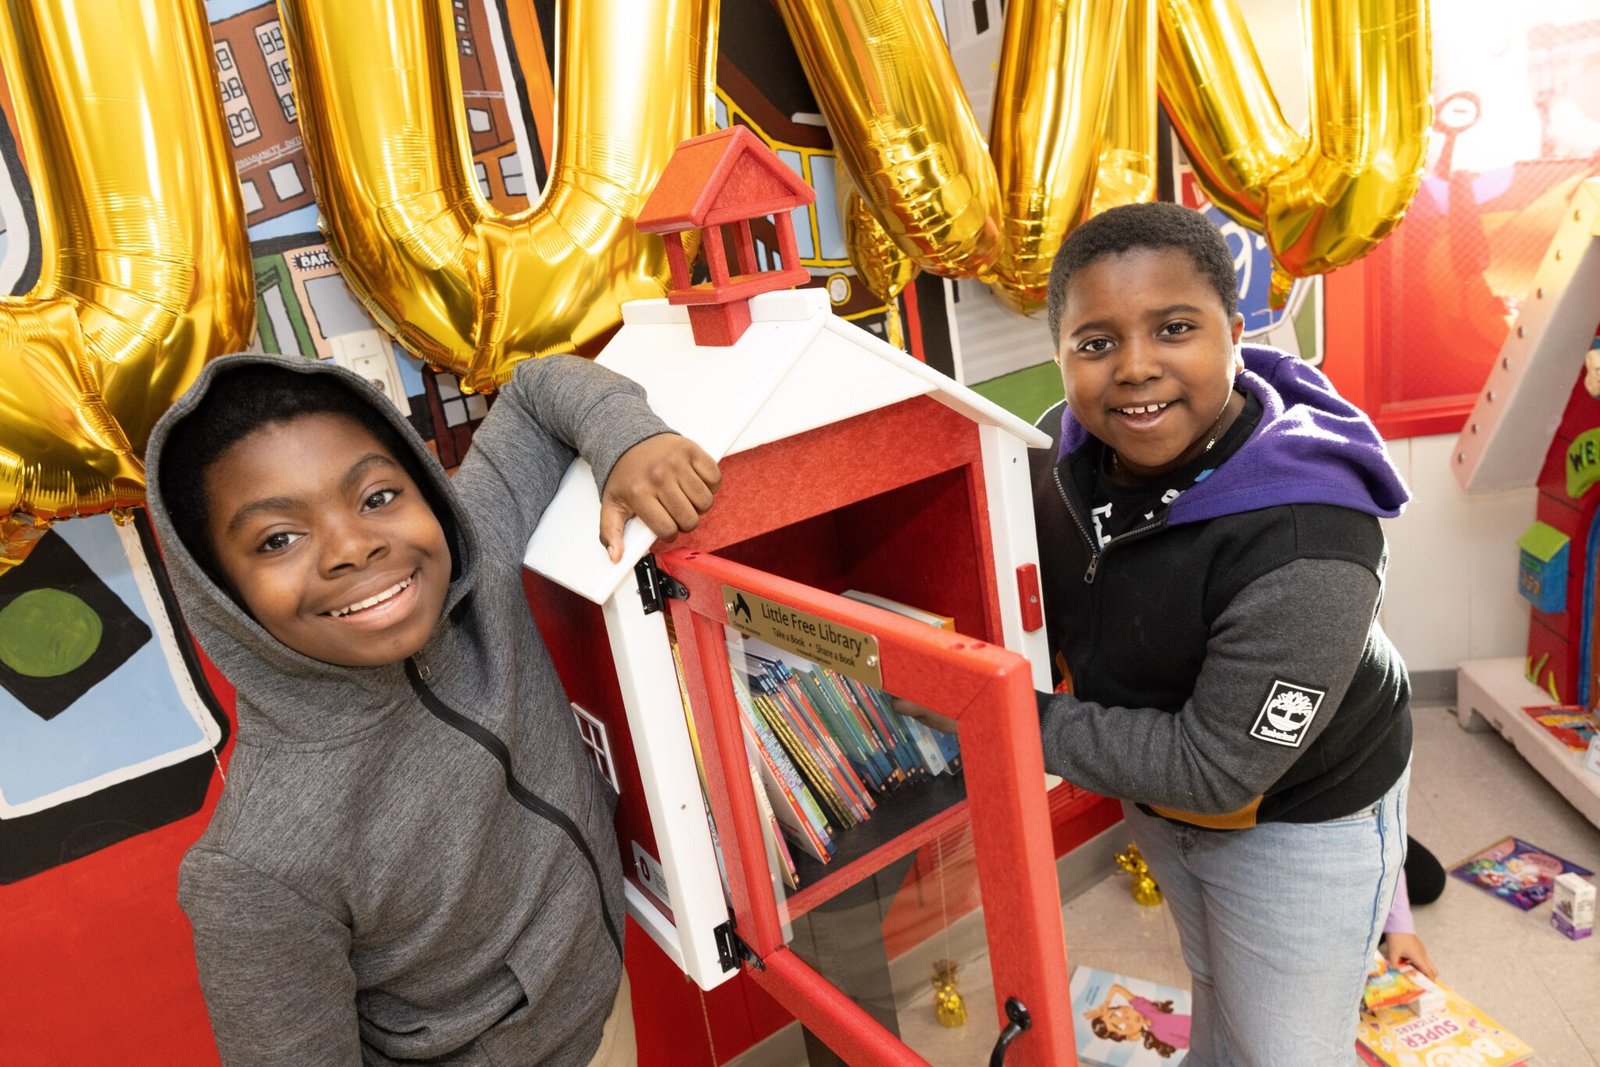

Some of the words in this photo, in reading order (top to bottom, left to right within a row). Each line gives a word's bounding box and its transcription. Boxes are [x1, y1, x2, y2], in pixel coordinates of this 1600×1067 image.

[1569, 440, 1600, 473] WE
[761, 602, 789, 626] Little
[791, 613, 816, 637] Free
[818, 623, 861, 657] Library
[772, 627, 786, 640] Take
[790, 635, 805, 647] Book
[816, 644, 833, 660] Share
[839, 653, 856, 667] Book
[1406, 1020, 1459, 1049] SUPER
